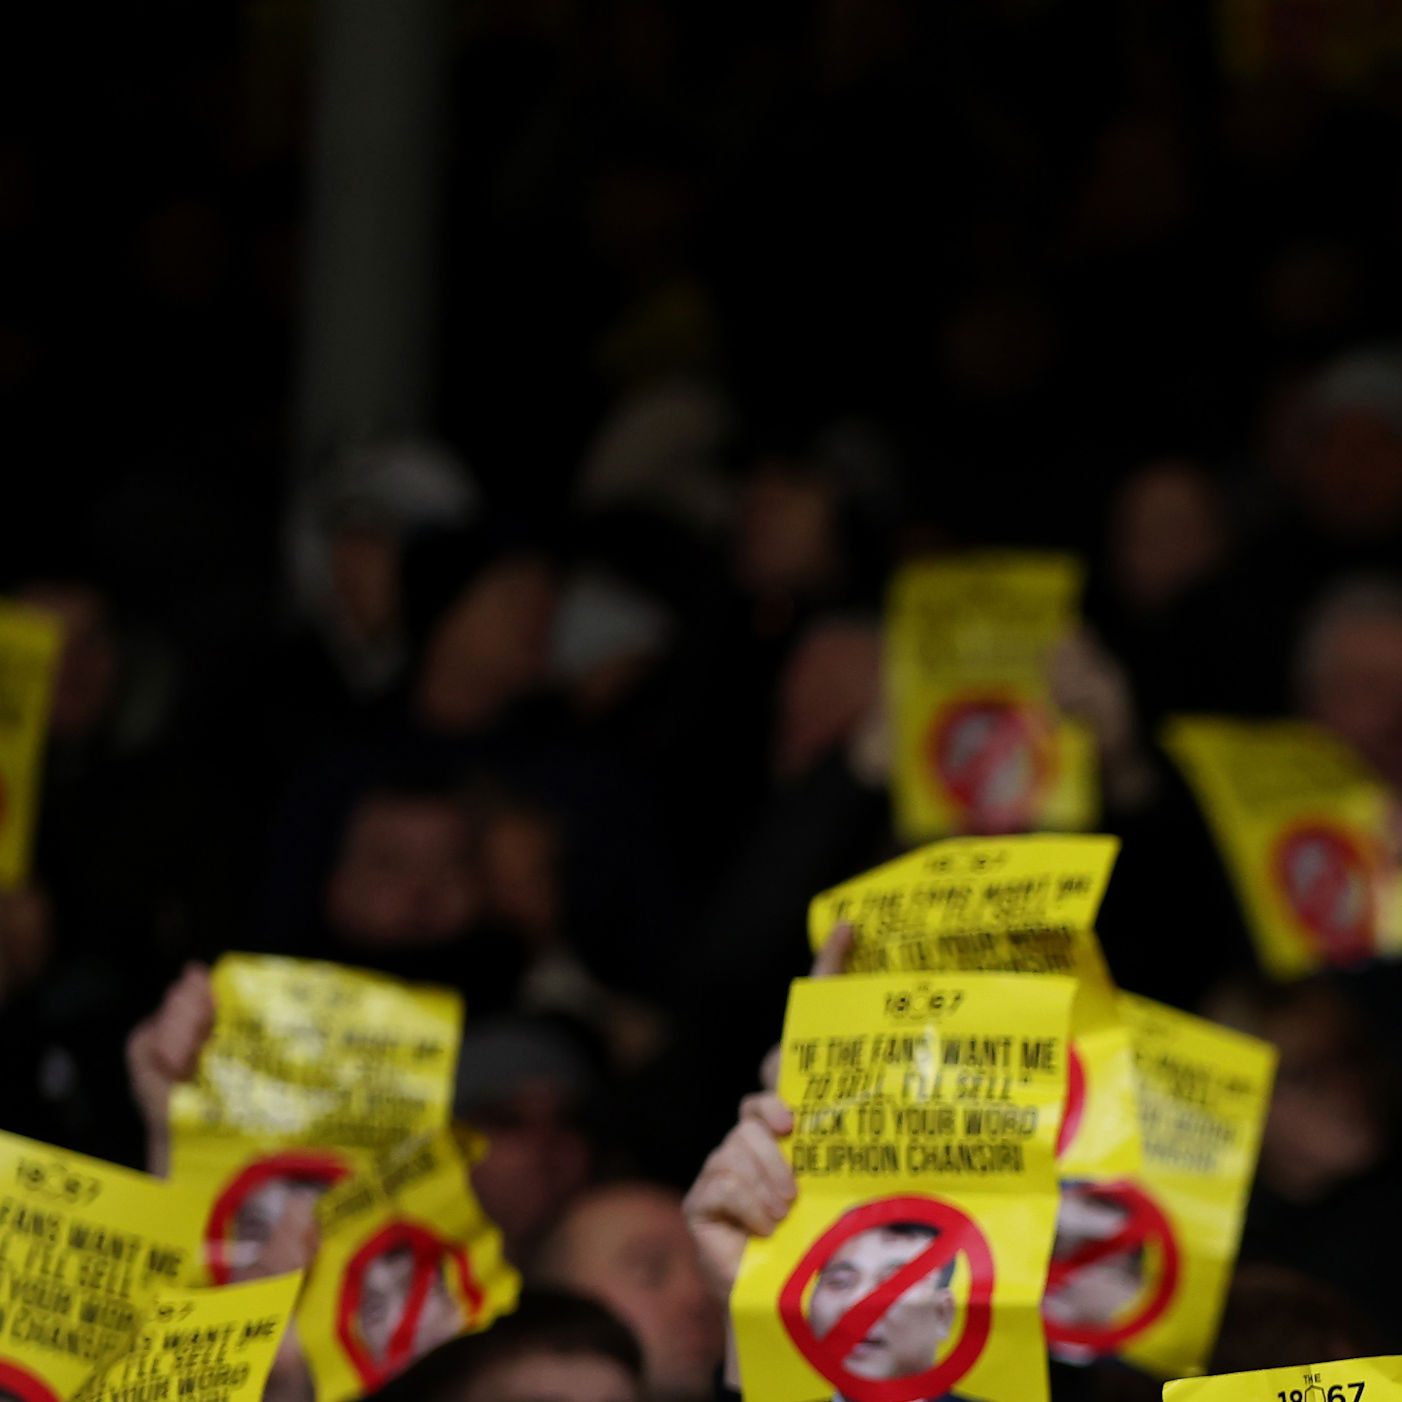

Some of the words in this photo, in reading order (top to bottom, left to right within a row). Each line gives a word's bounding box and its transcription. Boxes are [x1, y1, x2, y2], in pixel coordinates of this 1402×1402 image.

[826, 1033, 868, 1067] THE
[942, 1034, 1012, 1067] WANT
[1021, 1038, 1057, 1074] ME
[804, 1075, 831, 1101] TO
[857, 1107, 885, 1135] TO
[896, 1106, 955, 1136] YOUR
[965, 1107, 1039, 1137] WORD
[792, 1143, 898, 1176] DEJPHON
[907, 1144, 1024, 1176] CHANSIRI
[1303, 1374, 1321, 1384] THE
